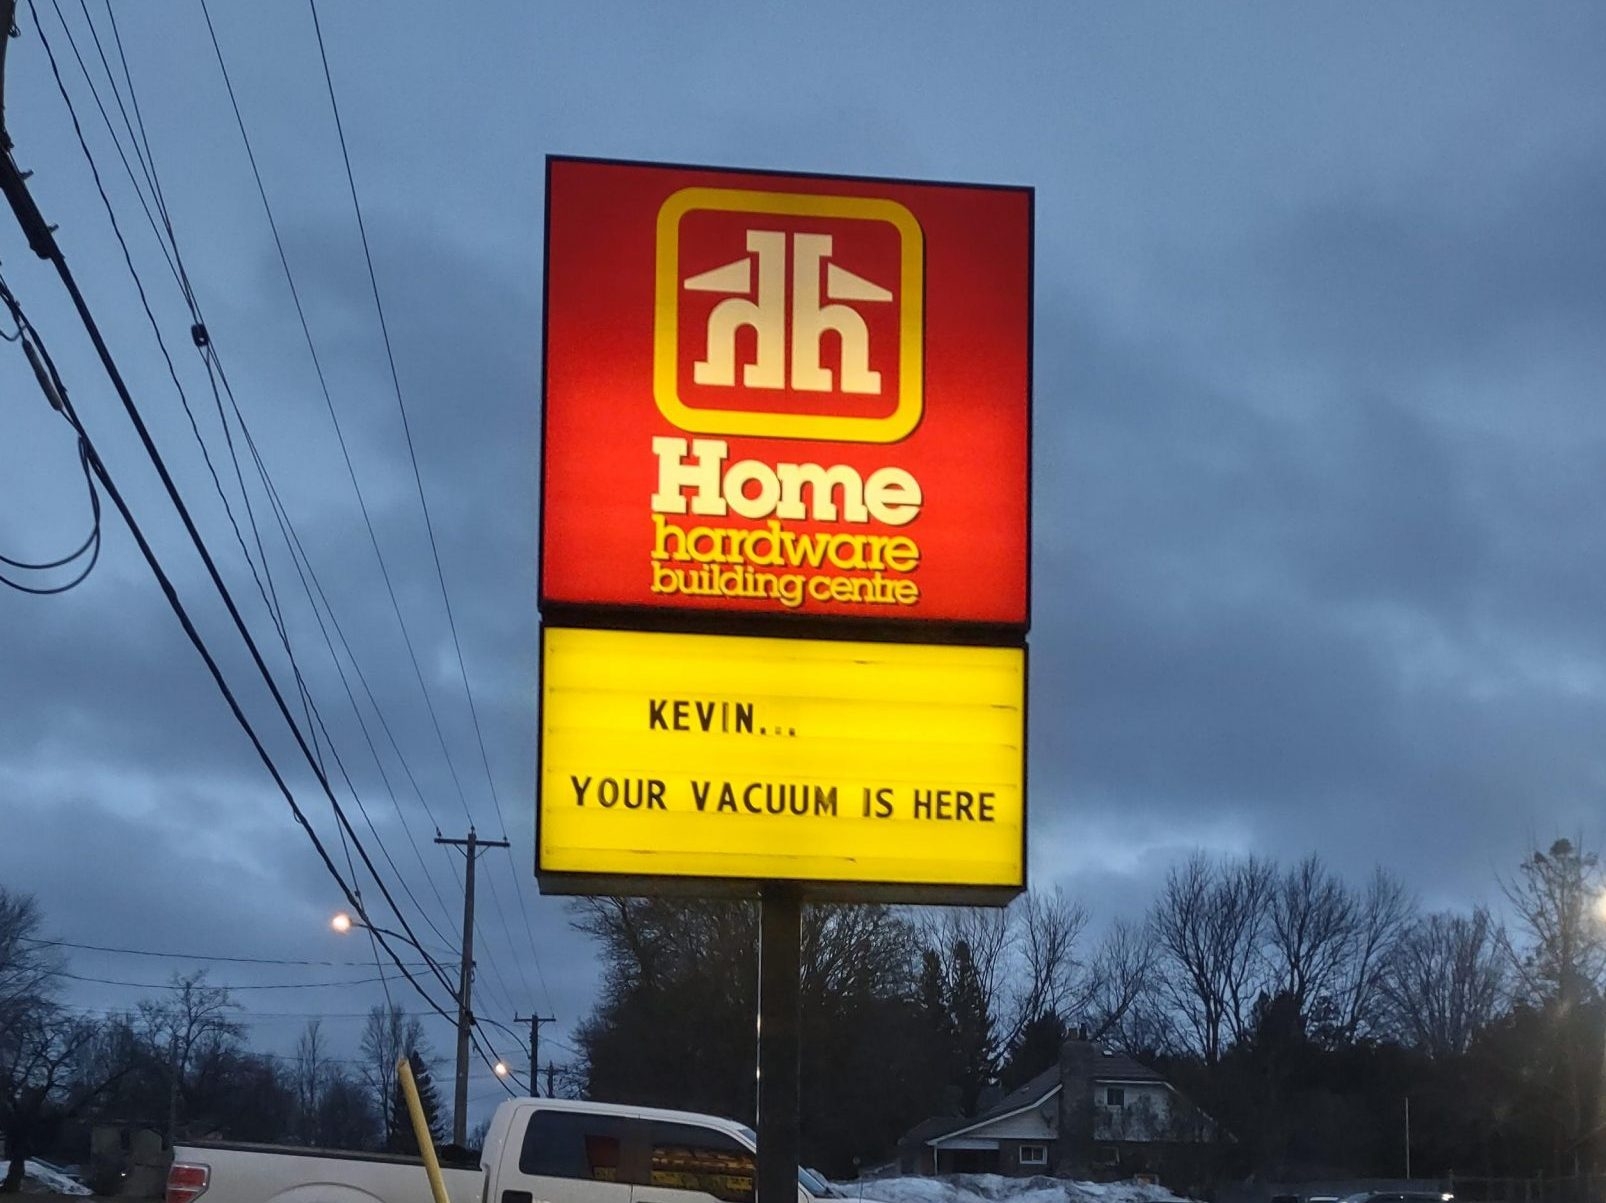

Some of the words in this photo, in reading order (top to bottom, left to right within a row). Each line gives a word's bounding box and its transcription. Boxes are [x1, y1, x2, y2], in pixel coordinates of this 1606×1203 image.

[652, 436, 922, 525] Home
[651, 513, 919, 571] hardware
[651, 561, 805, 607] building
[809, 571, 919, 604] centre
[570, 776, 667, 810] YOUR
[691, 781, 838, 816] VACUUM
[862, 787, 894, 818] IS
[913, 789, 996, 822] HERE
